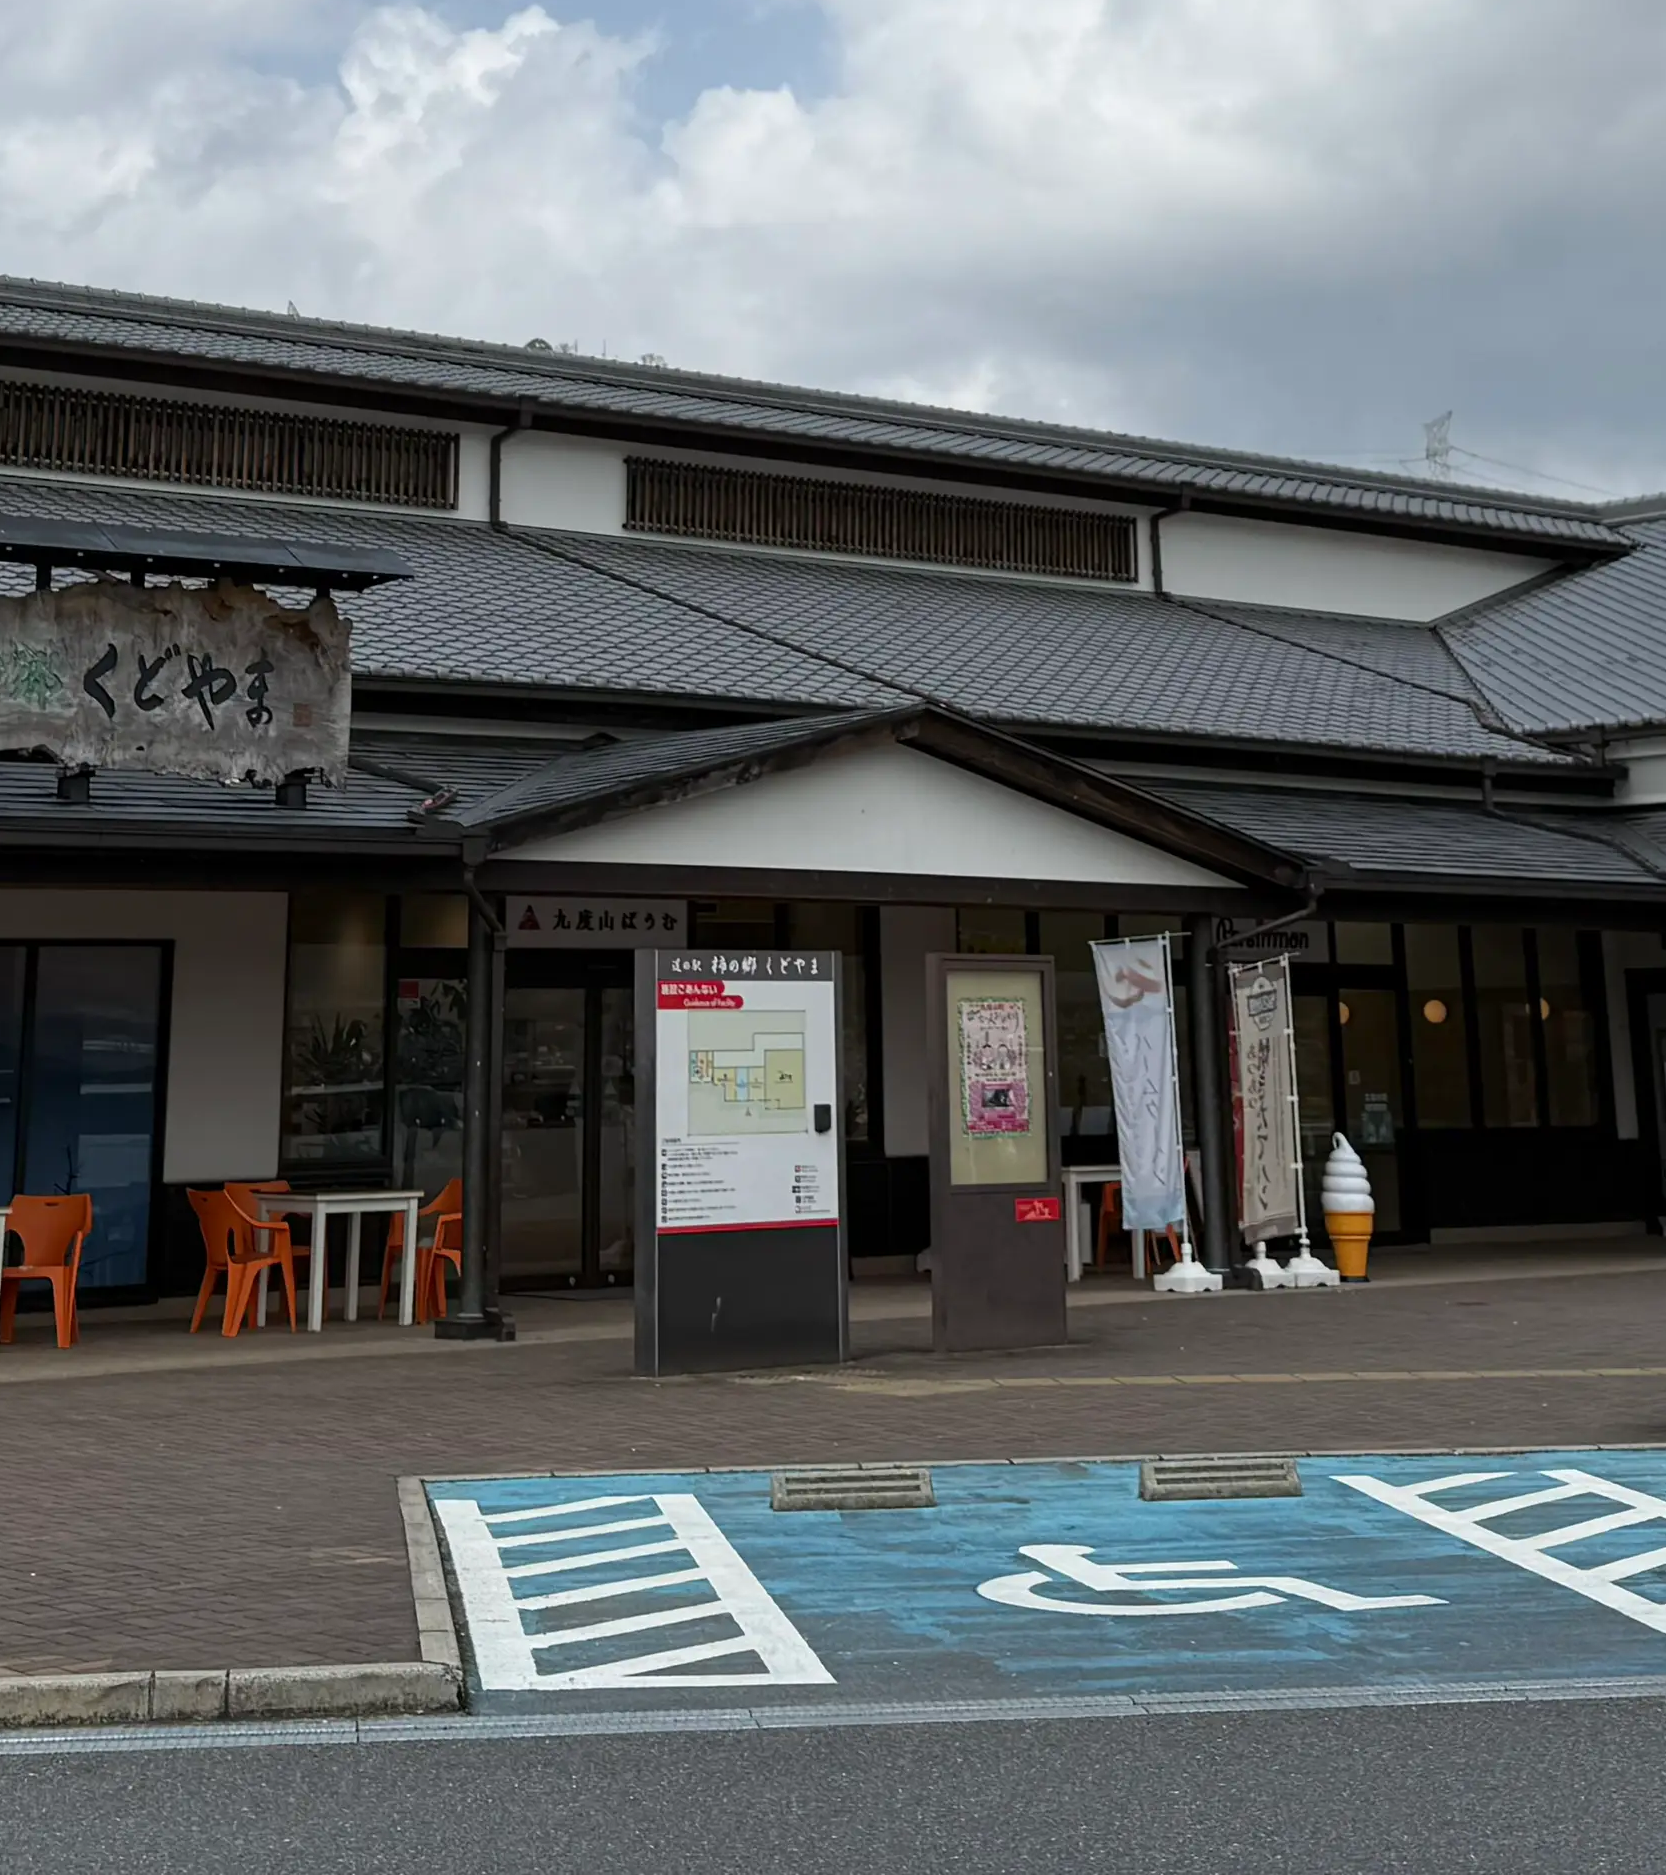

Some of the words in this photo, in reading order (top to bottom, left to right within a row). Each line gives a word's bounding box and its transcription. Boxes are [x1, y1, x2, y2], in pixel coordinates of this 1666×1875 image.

[83, 643, 275, 731] くどやま
[766, 956, 819, 975] くどやま
